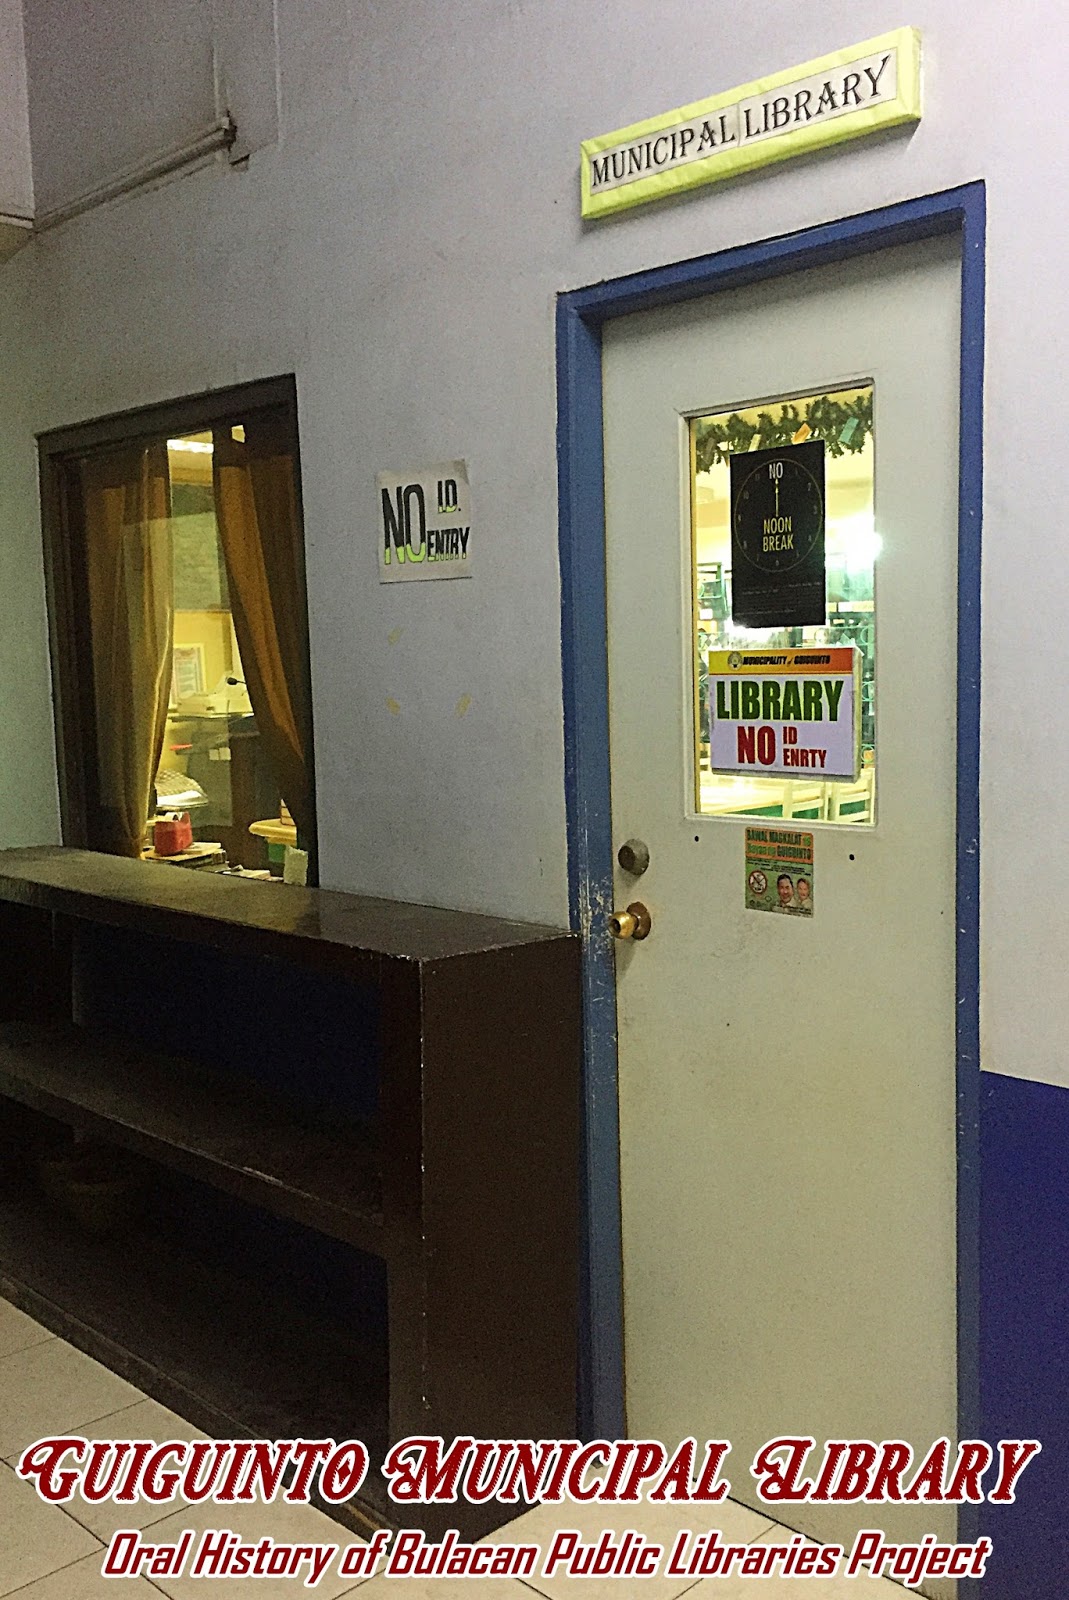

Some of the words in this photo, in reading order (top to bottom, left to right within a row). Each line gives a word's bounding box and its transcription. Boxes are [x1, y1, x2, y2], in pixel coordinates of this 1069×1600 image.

[591, 115, 736, 187] MUNICIPAL
[743, 53, 891, 140] LIBRARY
[768, 462, 784, 480] NO
[381, 483, 426, 565] NO
[763, 516, 792, 534] NOON
[426, 526, 471, 562] ENTRY
[762, 534, 794, 552] BREAK
[716, 679, 844, 722] LIBRARY
[737, 725, 776, 766] NO
[782, 726, 798, 745] ID
[782, 748, 827, 768] ENRTY
